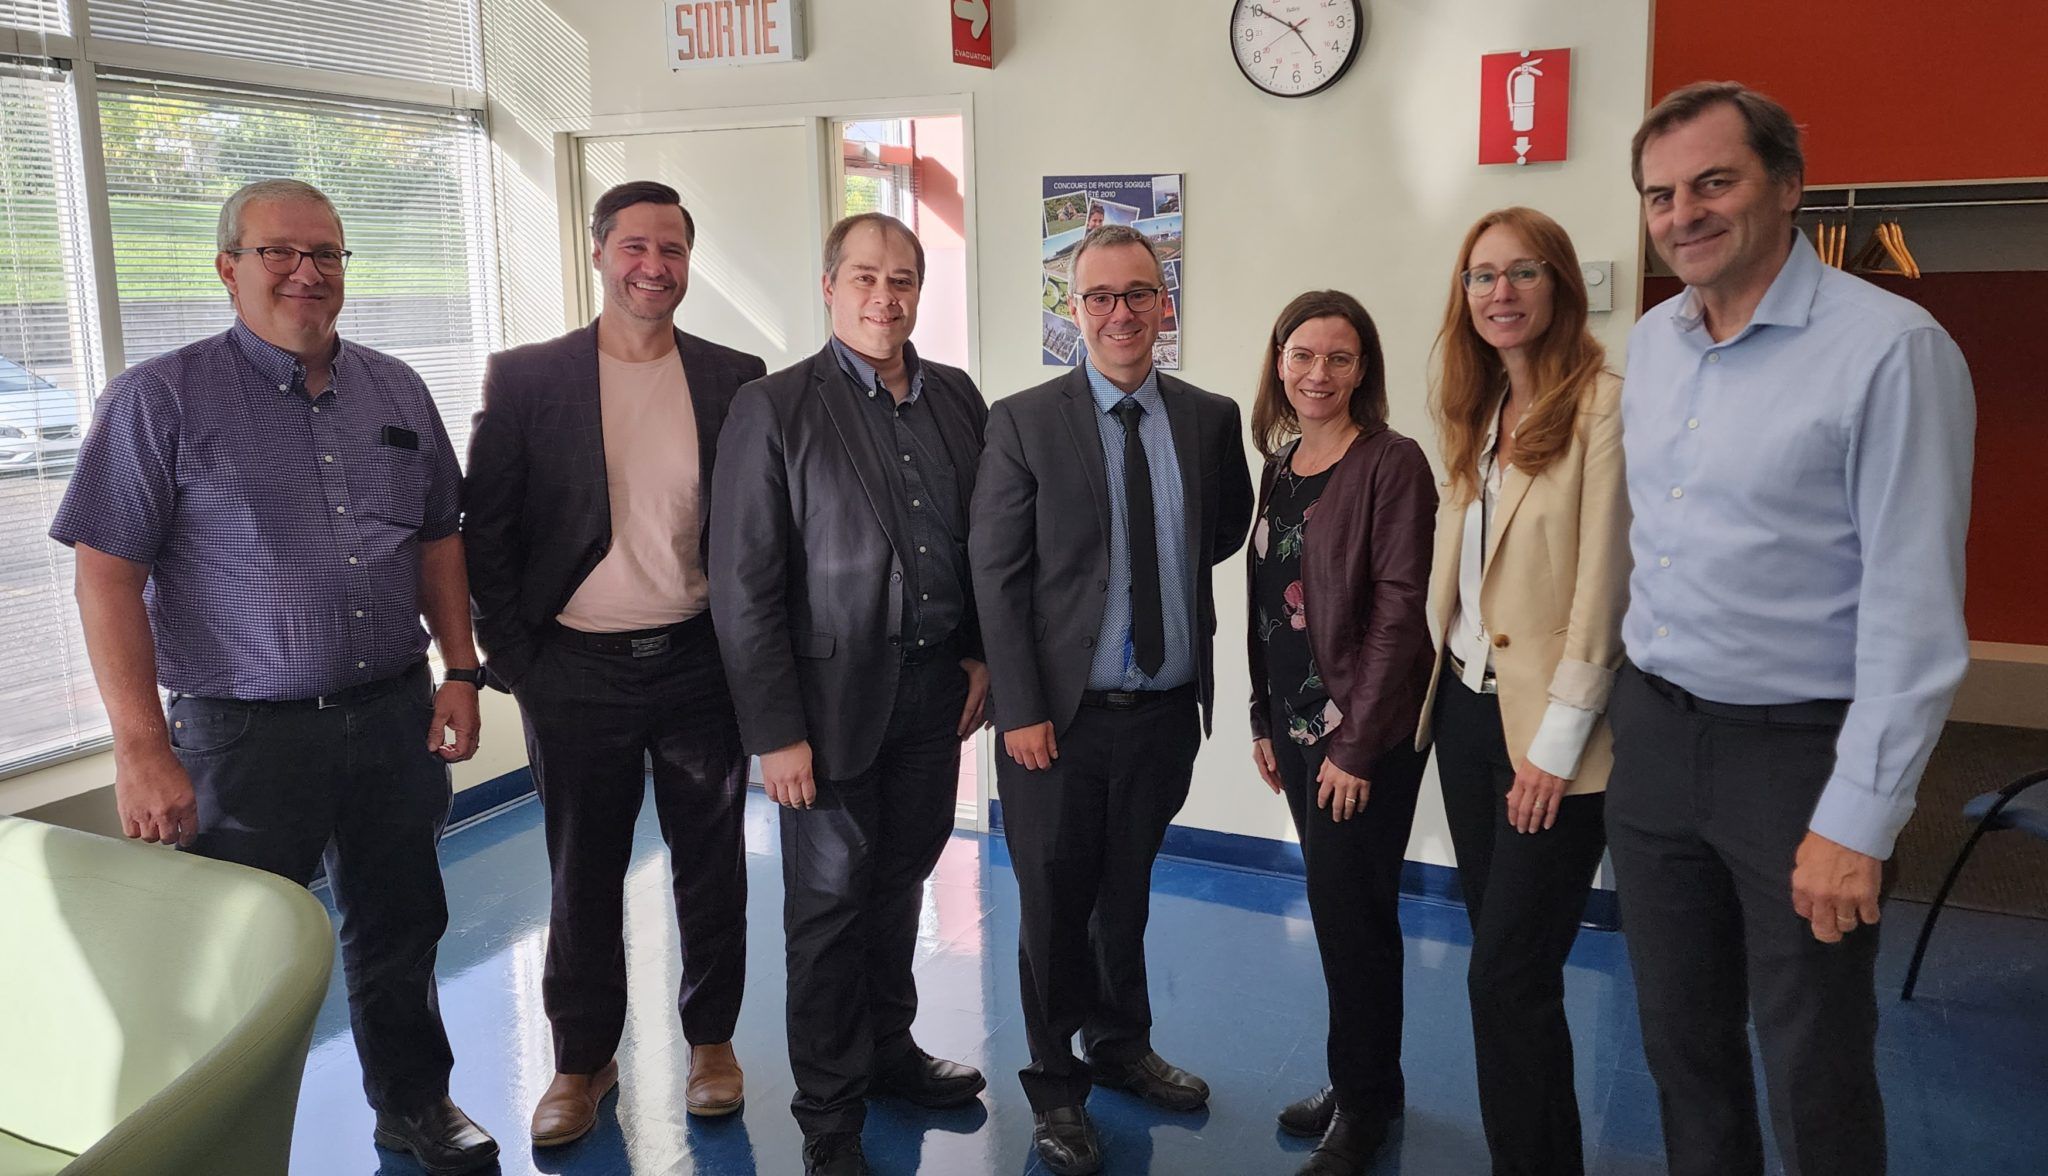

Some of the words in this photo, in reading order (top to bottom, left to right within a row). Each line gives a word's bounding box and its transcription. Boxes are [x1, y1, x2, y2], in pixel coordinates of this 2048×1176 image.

[1336, 16, 1345, 28] 3
[675, 0, 780, 60] SORTIE
[1245, 29, 1253, 41] 9
[1331, 40, 1340, 52] 4
[1253, 51, 1261, 63] 8
[1270, 66, 1278, 79] 7
[1314, 61, 1322, 74] 5
[1292, 71, 1301, 83] 6
[1053, 182, 1087, 190] CONCOURS
[1088, 181, 1097, 189] DE
[1098, 181, 1124, 189] PHOTOS
[1100, 190, 1116, 198] 2010
